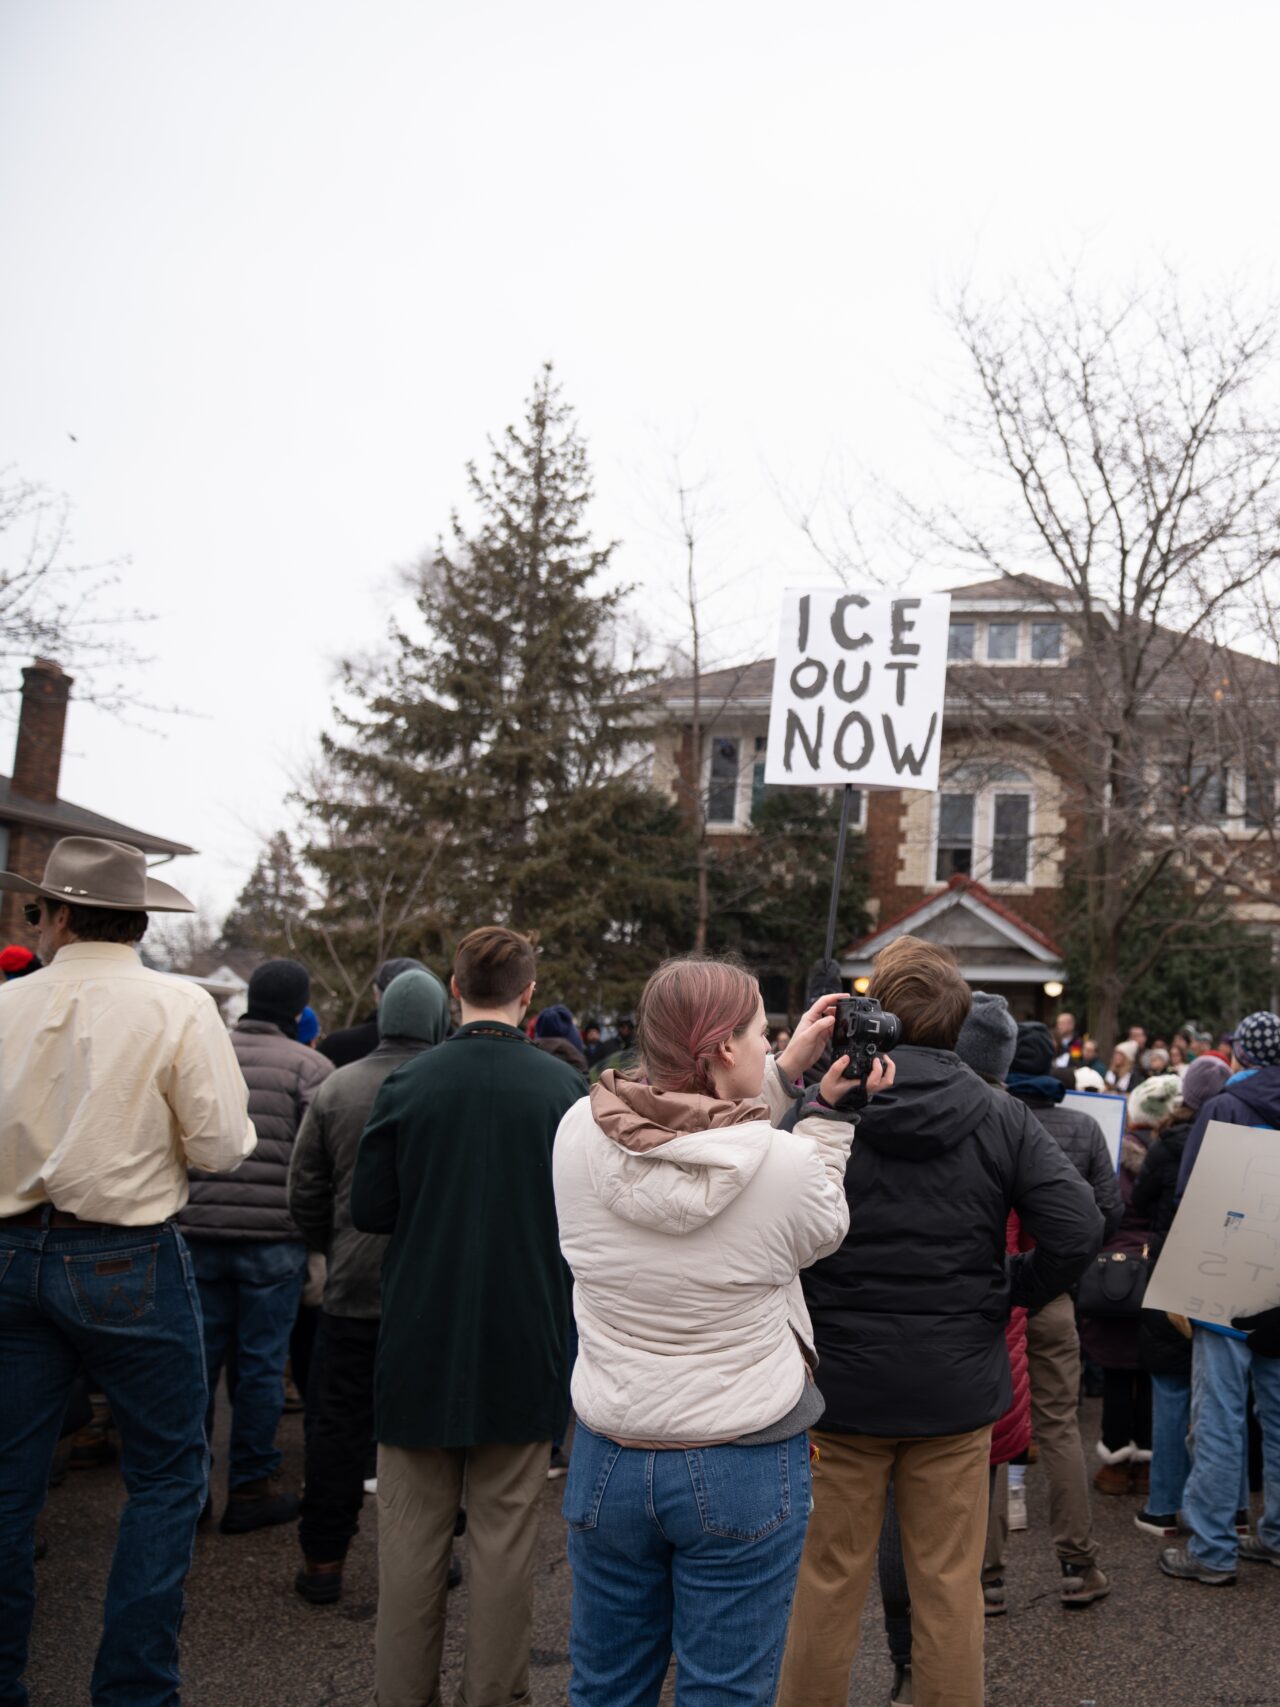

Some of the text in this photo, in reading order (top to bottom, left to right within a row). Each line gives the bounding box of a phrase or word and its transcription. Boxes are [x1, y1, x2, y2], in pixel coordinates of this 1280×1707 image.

[798, 594, 922, 656] ICE
[790, 657, 919, 706] OUT
[783, 705, 938, 776] NOW
